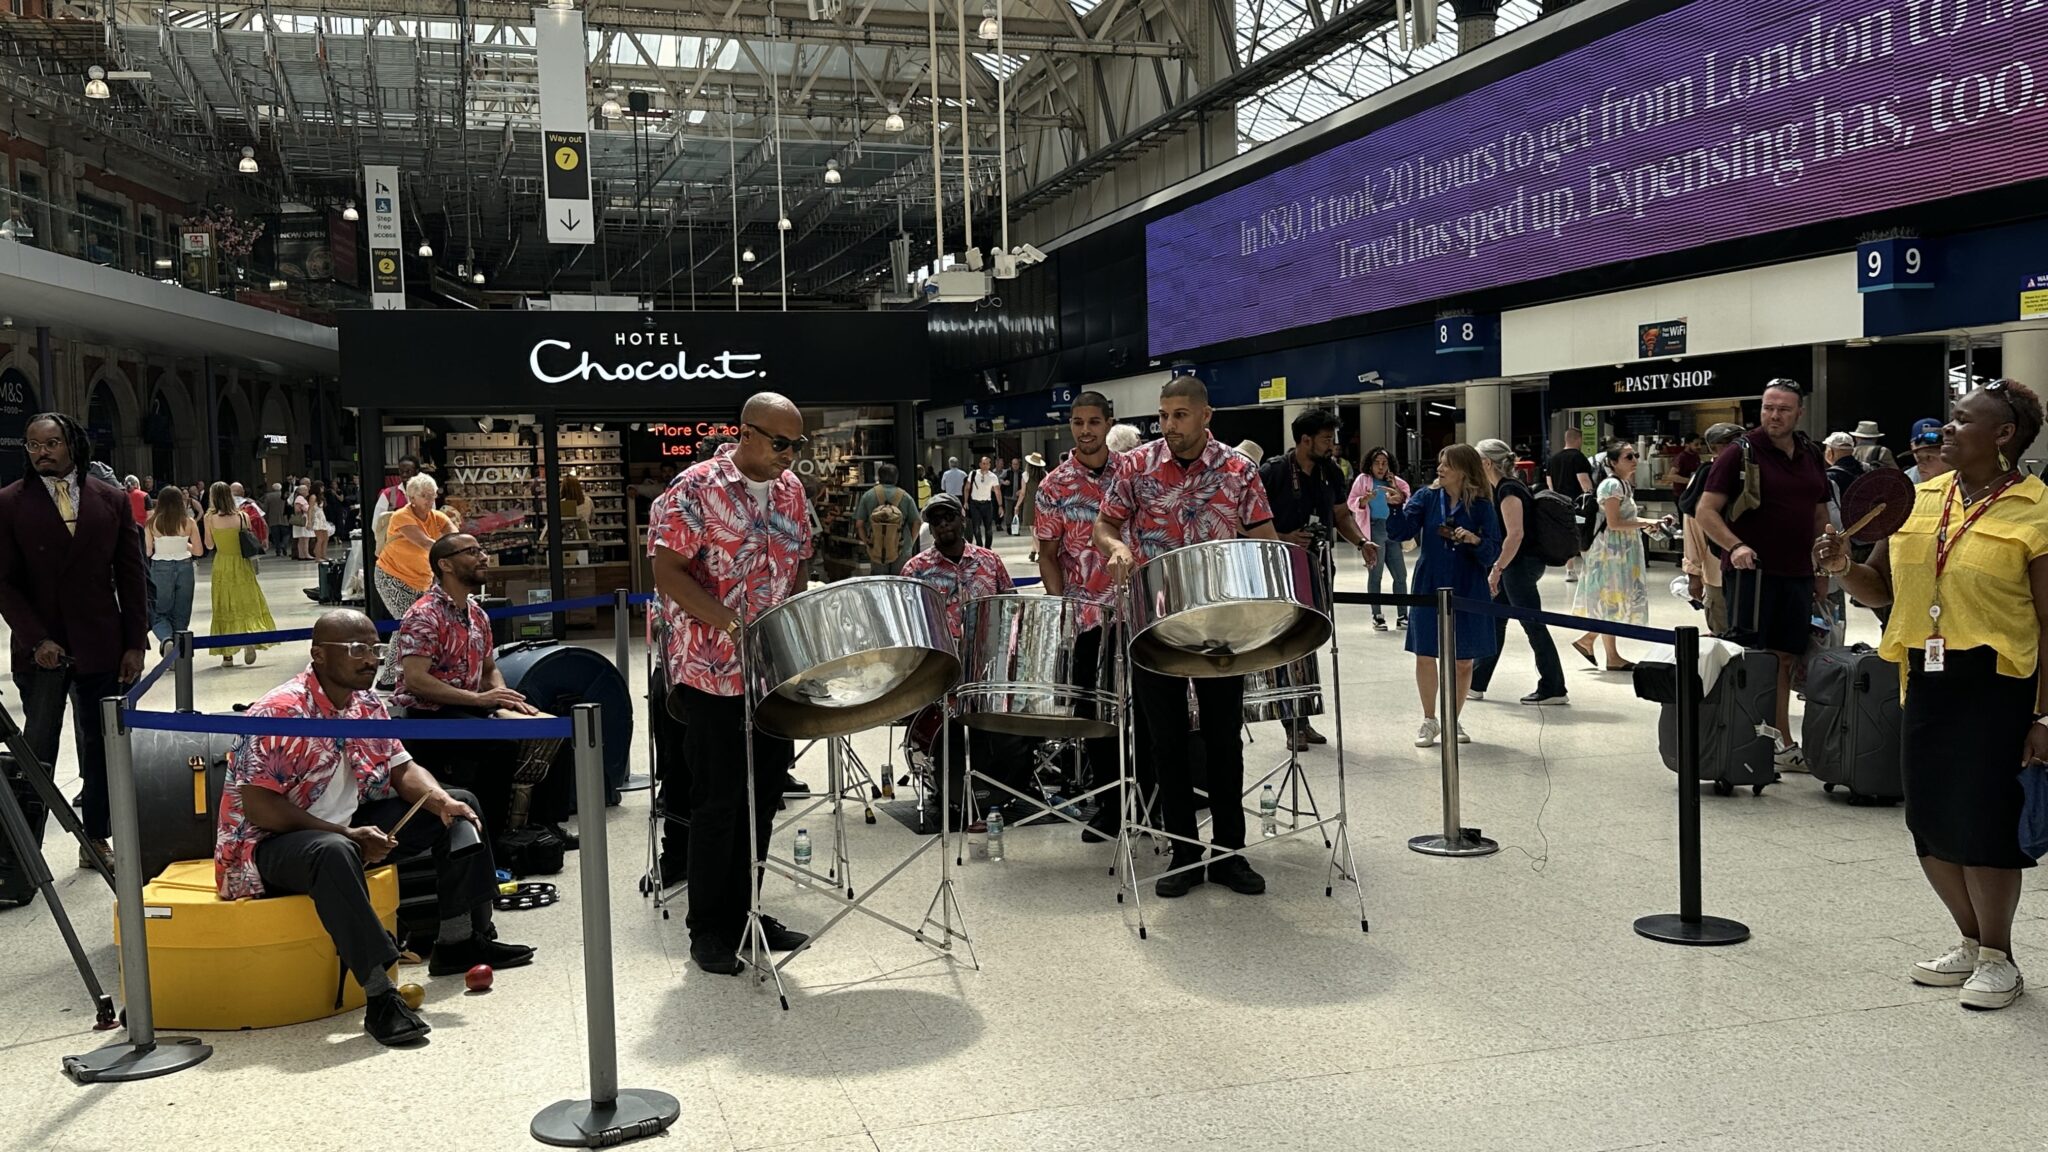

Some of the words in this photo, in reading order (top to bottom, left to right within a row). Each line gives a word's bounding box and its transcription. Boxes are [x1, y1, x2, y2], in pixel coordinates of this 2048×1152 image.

[549, 134, 568, 144] Way
[569, 136, 583, 144] out
[1240, 220, 1258, 256] In
[1261, 201, 1307, 241] 1830,
[1310, 195, 1325, 234] it
[1328, 175, 1378, 228] took
[1382, 160, 1414, 211] 20
[1418, 141, 1498, 200] hours
[1502, 130, 1535, 172] to
[1539, 103, 1594, 175] get
[1600, 76, 1696, 141] from
[1702, 9, 1895, 110] London
[562, 153, 571, 165] 7
[1335, 221, 1403, 279] Travel
[1407, 218, 1452, 263] has
[1455, 185, 1526, 259] sped
[1529, 186, 1581, 238] up.
[1587, 121, 1804, 220] Expensing
[1811, 95, 1916, 162] has,
[1926, 60, 2047, 133] too.
[376, 215, 393, 223] Step
[280, 231, 301, 239] NOW
[303, 231, 326, 239] OPEN
[383, 262, 390, 270] 2
[1867, 250, 1882, 278] 9
[1905, 247, 1921, 274] 9
[615, 332, 683, 345] HOTEL
[1440, 324, 1448, 343] 8
[1462, 322, 1474, 341] 8
[529, 339, 767, 384] Chocolat.
[1626, 375, 1669, 392] PASTY
[1672, 369, 1713, 389] SHOP
[0, 381, 24, 403] M&S
[1062, 390, 1071, 401] 6
[972, 404, 979, 415] 5
[655, 423, 692, 437] More
[696, 422, 739, 436] Cacao
[662, 442, 692, 456] Less
[453, 455, 489, 467] GIFT
[454, 467, 529, 484] WOW
